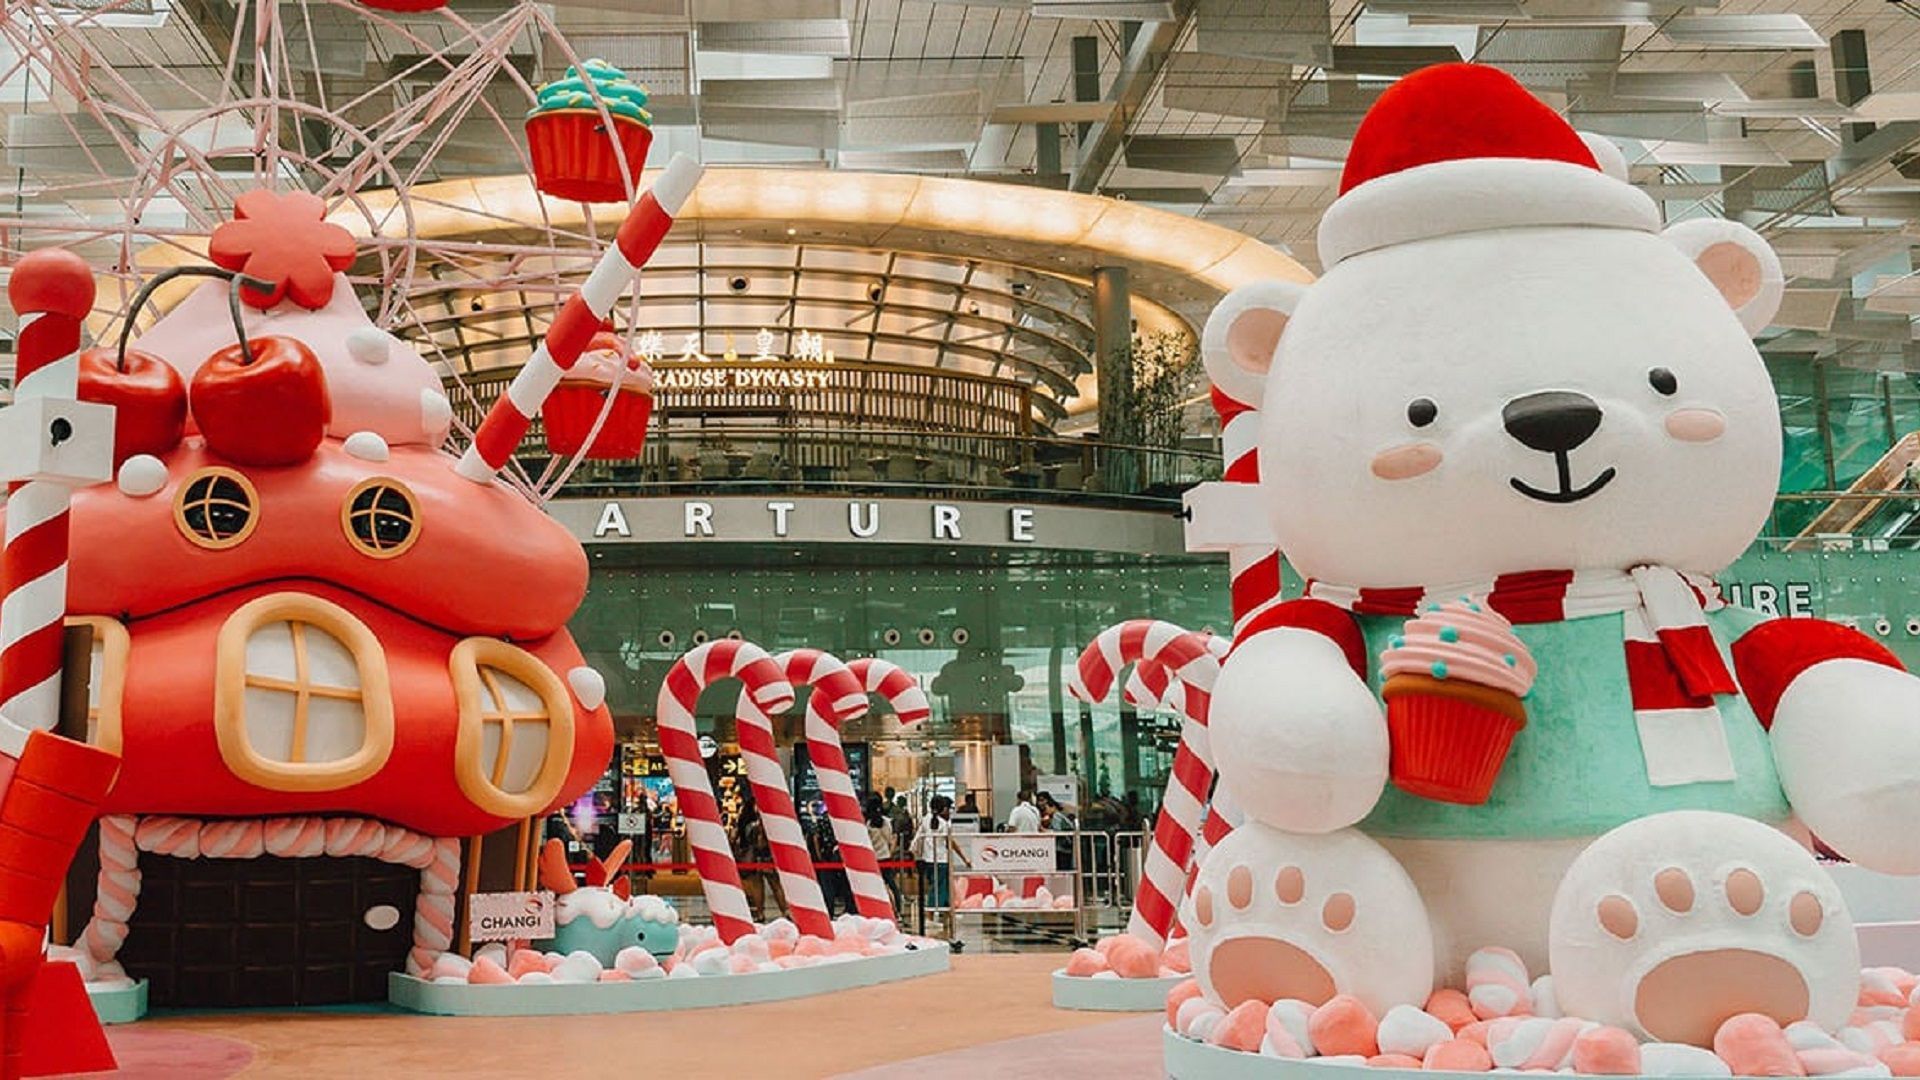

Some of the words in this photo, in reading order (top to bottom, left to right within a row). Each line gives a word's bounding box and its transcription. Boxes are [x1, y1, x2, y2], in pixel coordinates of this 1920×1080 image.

[735, 369, 831, 387] DYNASTY
[1001, 848, 1049, 858] CHANGI
[481, 915, 541, 929] CHANGI
